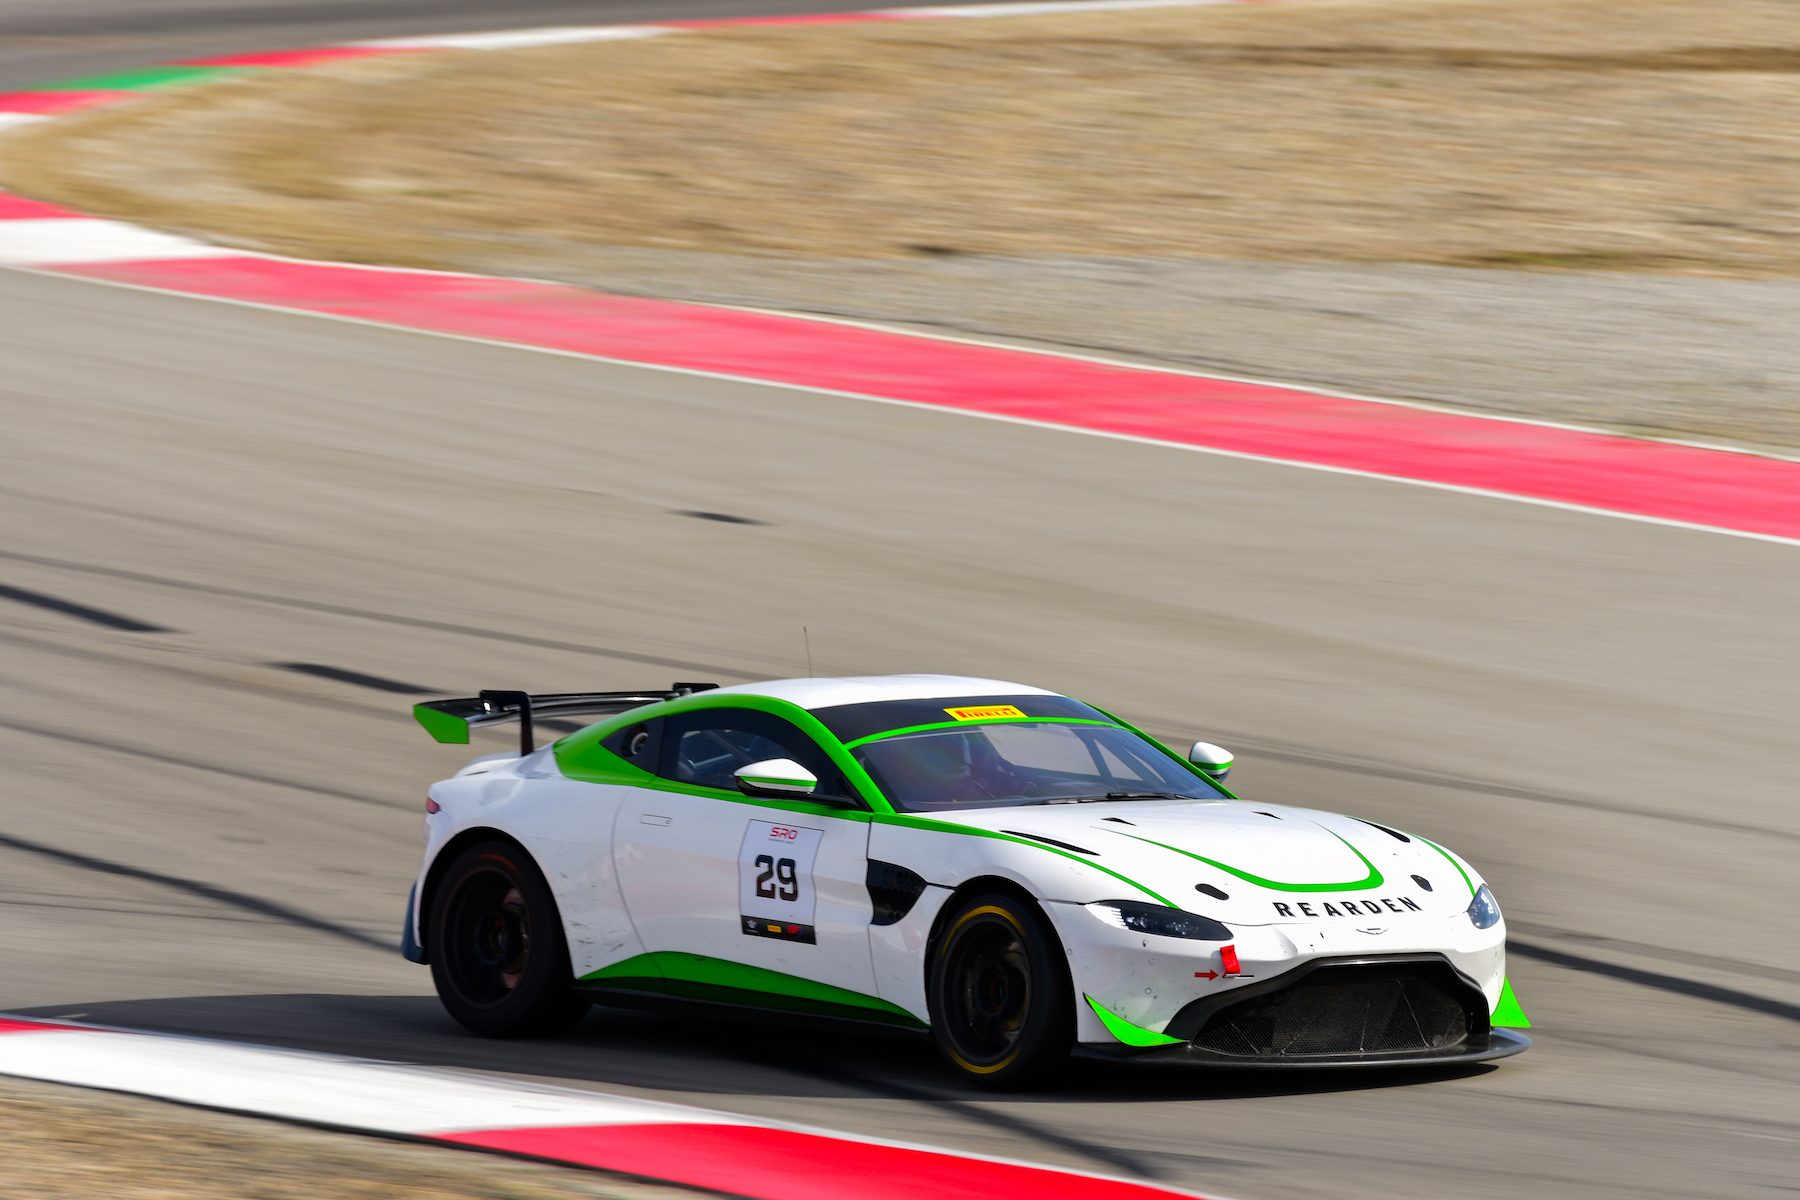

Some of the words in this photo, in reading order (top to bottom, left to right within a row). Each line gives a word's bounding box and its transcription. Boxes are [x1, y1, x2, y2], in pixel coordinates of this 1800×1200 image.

[770, 827, 798, 840] SRO
[755, 854, 798, 902] 29
[1272, 897, 1423, 917] REARDEN
